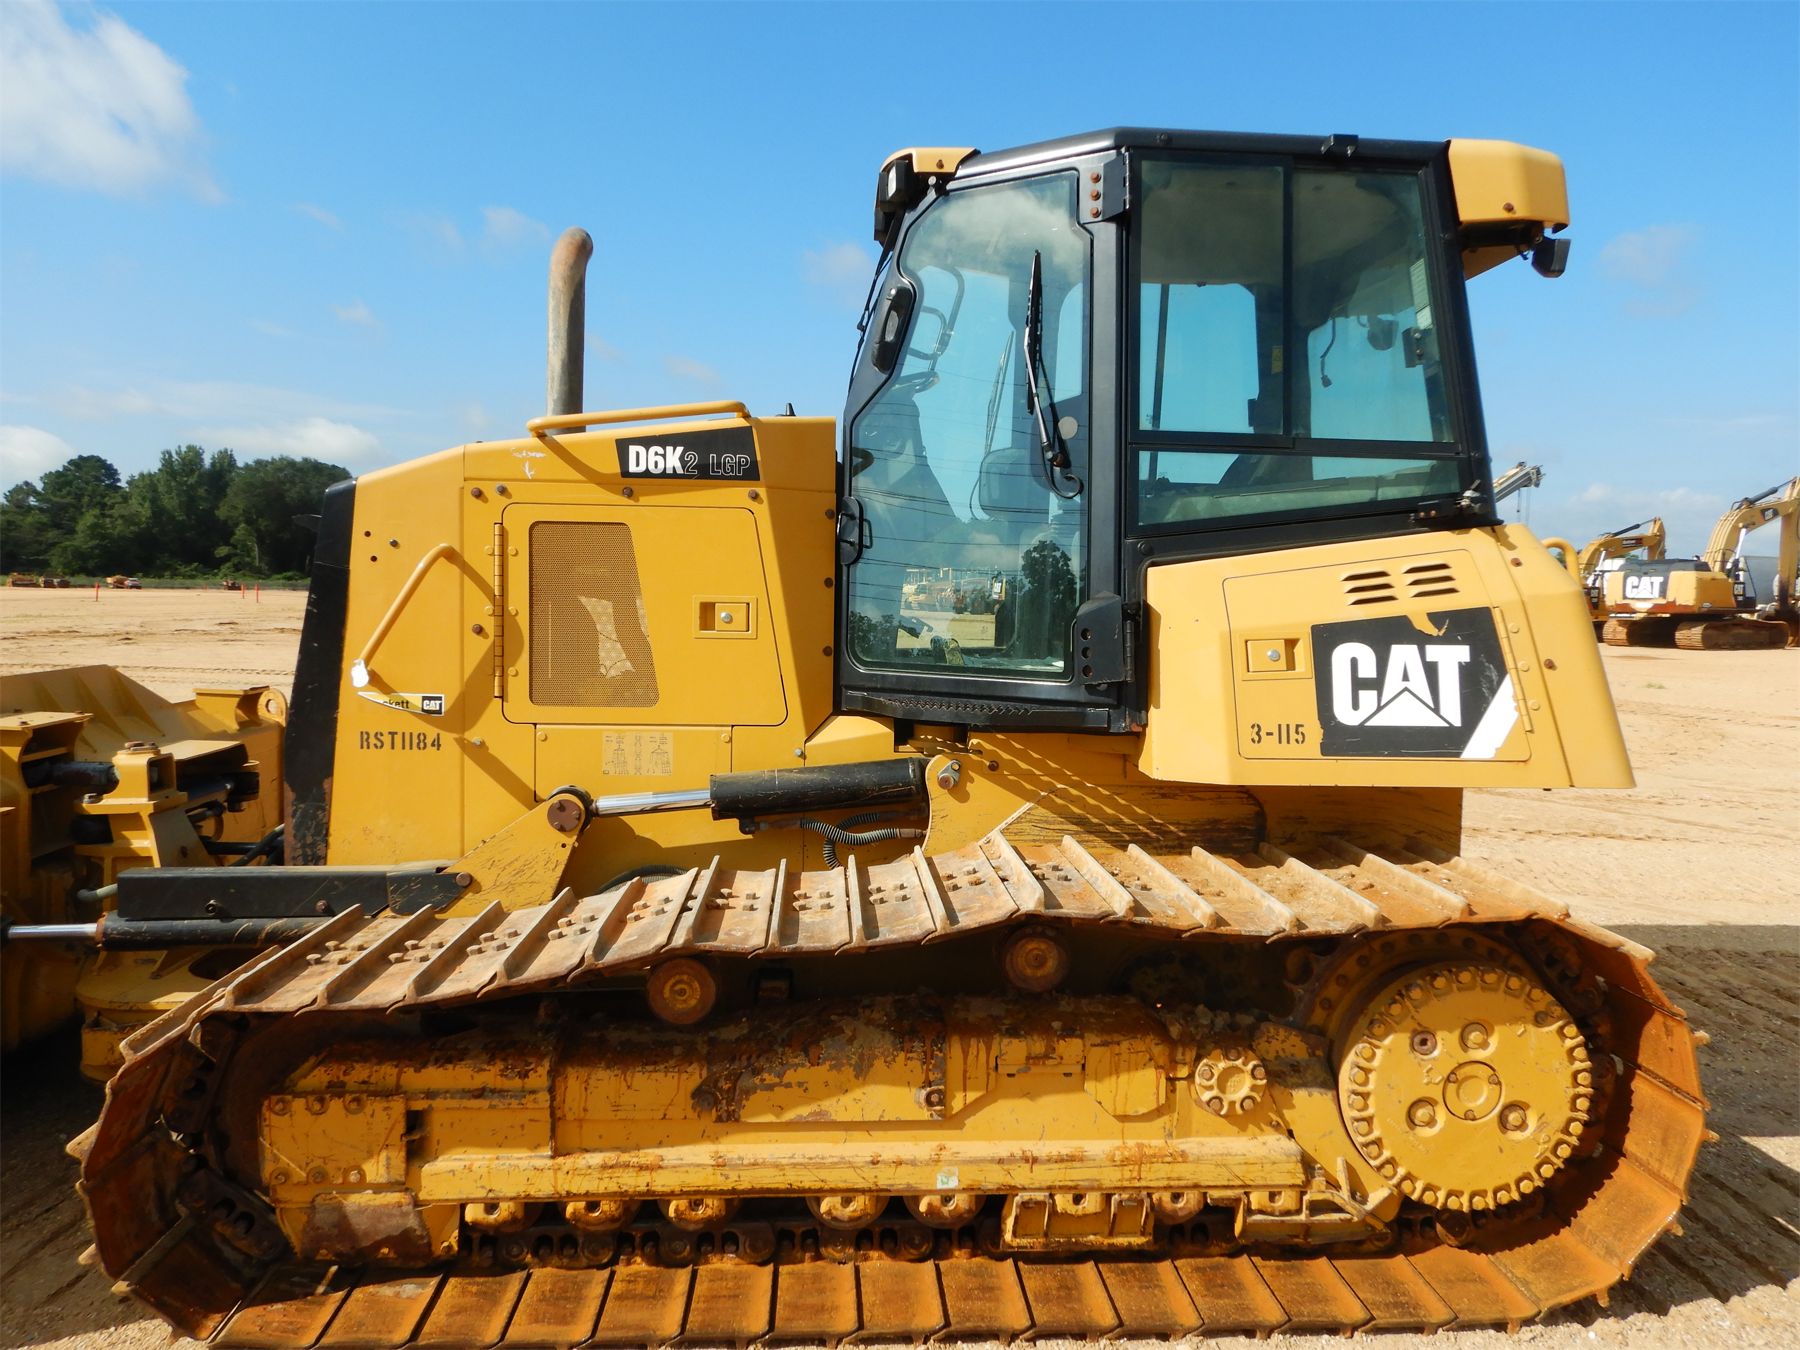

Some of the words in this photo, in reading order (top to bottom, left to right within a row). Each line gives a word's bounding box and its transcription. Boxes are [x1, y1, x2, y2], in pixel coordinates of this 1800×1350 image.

[628, 445, 698, 475] D6K2
[709, 454, 750, 476] LGP
[1625, 576, 1664, 599] CAT
[1331, 642, 1470, 727] CAT
[423, 700, 442, 711] CAT
[1250, 723, 1306, 745] 3-115
